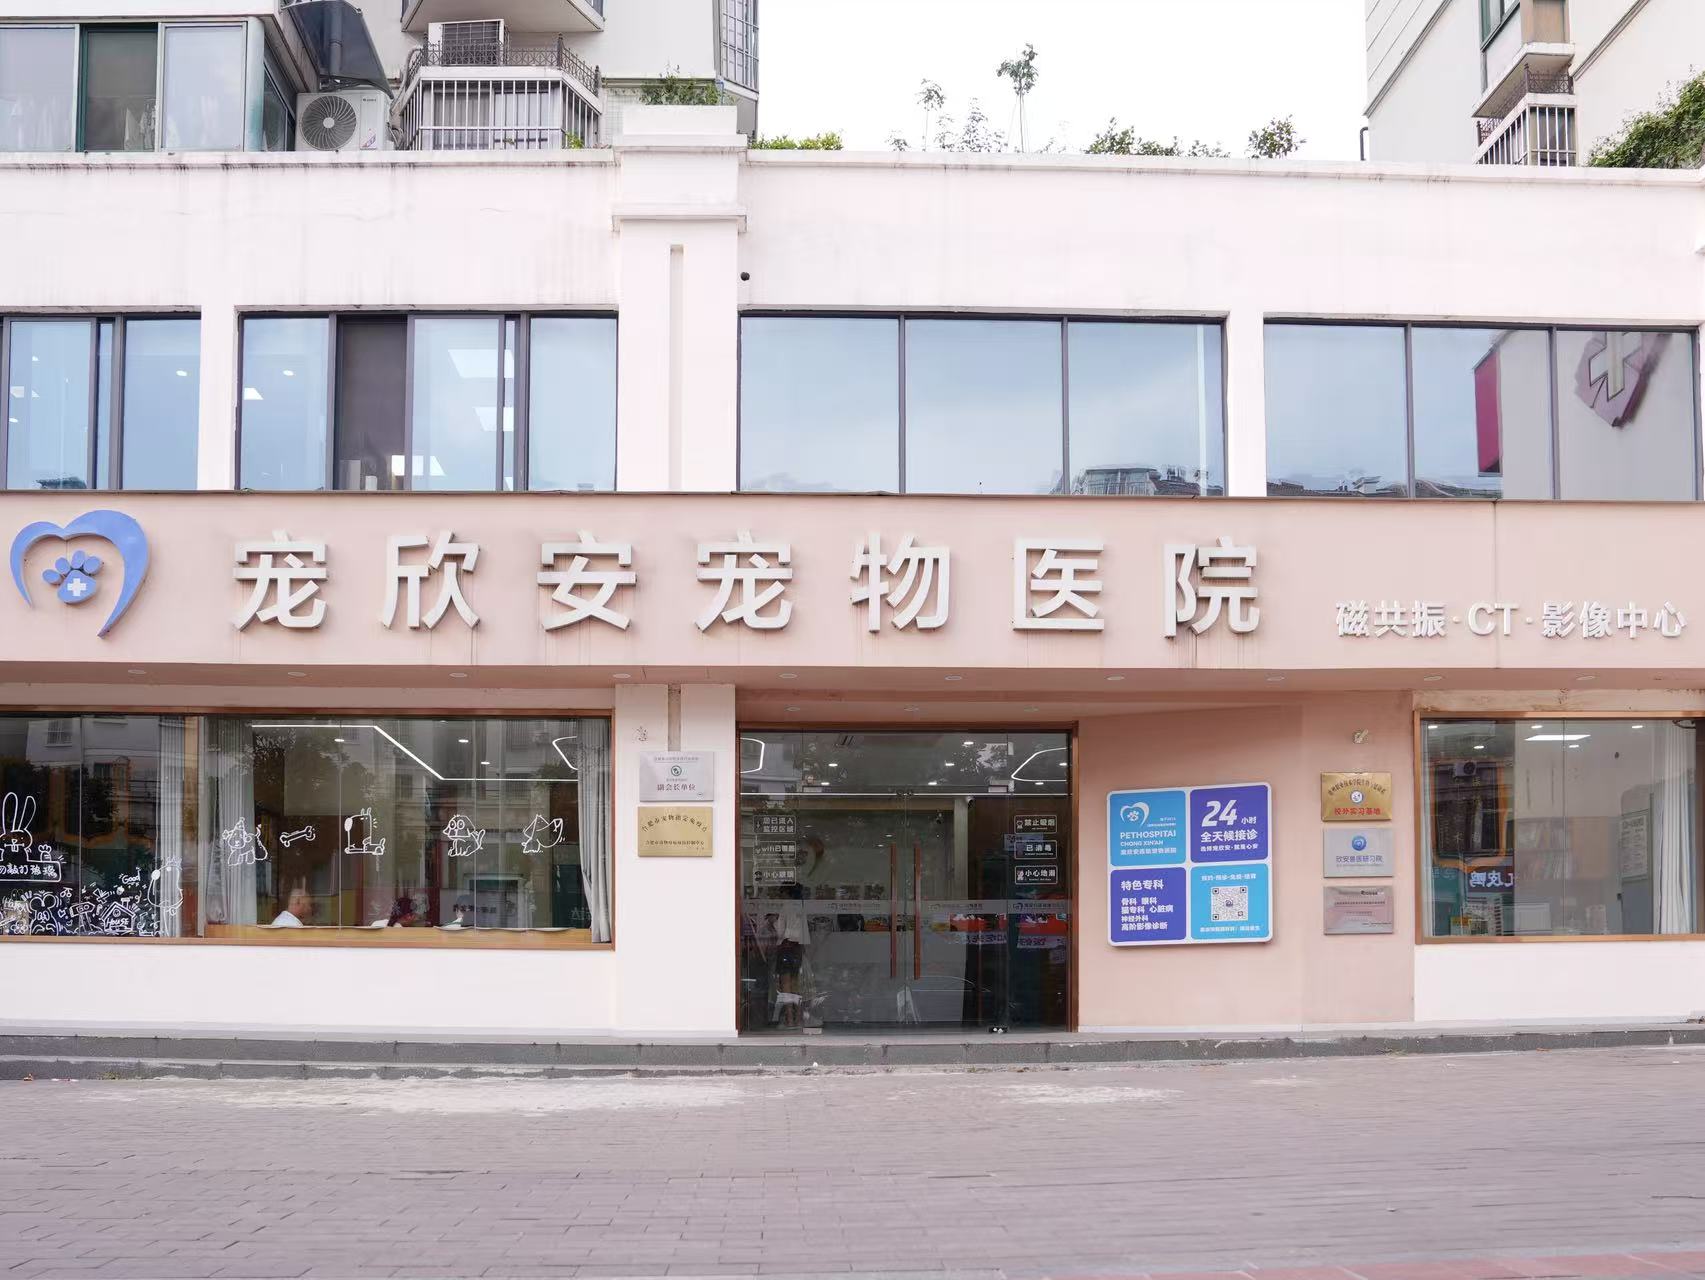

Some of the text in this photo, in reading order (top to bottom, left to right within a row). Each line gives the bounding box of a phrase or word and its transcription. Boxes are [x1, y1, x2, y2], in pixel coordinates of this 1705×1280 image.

[232, 528, 1260, 638] 宠欣安宠物医院
[1334, 600, 1688, 638] 磁共振·CT·影像中心
[656, 783, 697, 791] 副会长单位
[1201, 800, 1238, 827] 24
[1334, 807, 1381, 816] 校外实习基地
[1241, 816, 1257, 825] 小时
[1200, 829, 1258, 843] 全天候接诊
[1026, 844, 1052, 852] 已消毒
[1120, 840, 1142, 848] CHONG
[121, 868, 140, 884] Good
[1025, 869, 1056, 877] 小心地滑
[1120, 879, 1165, 891] 特色专科
[1121, 896, 1158, 906] 骨科 眼科
[76, 904, 90, 912] GO
[1121, 904, 1174, 915] 猫专科 心脏病
[107, 917, 130, 928] HOUSE
[1121, 914, 1149, 923] 神经外科
[1121, 921, 1168, 931] 高阶影像诊断
